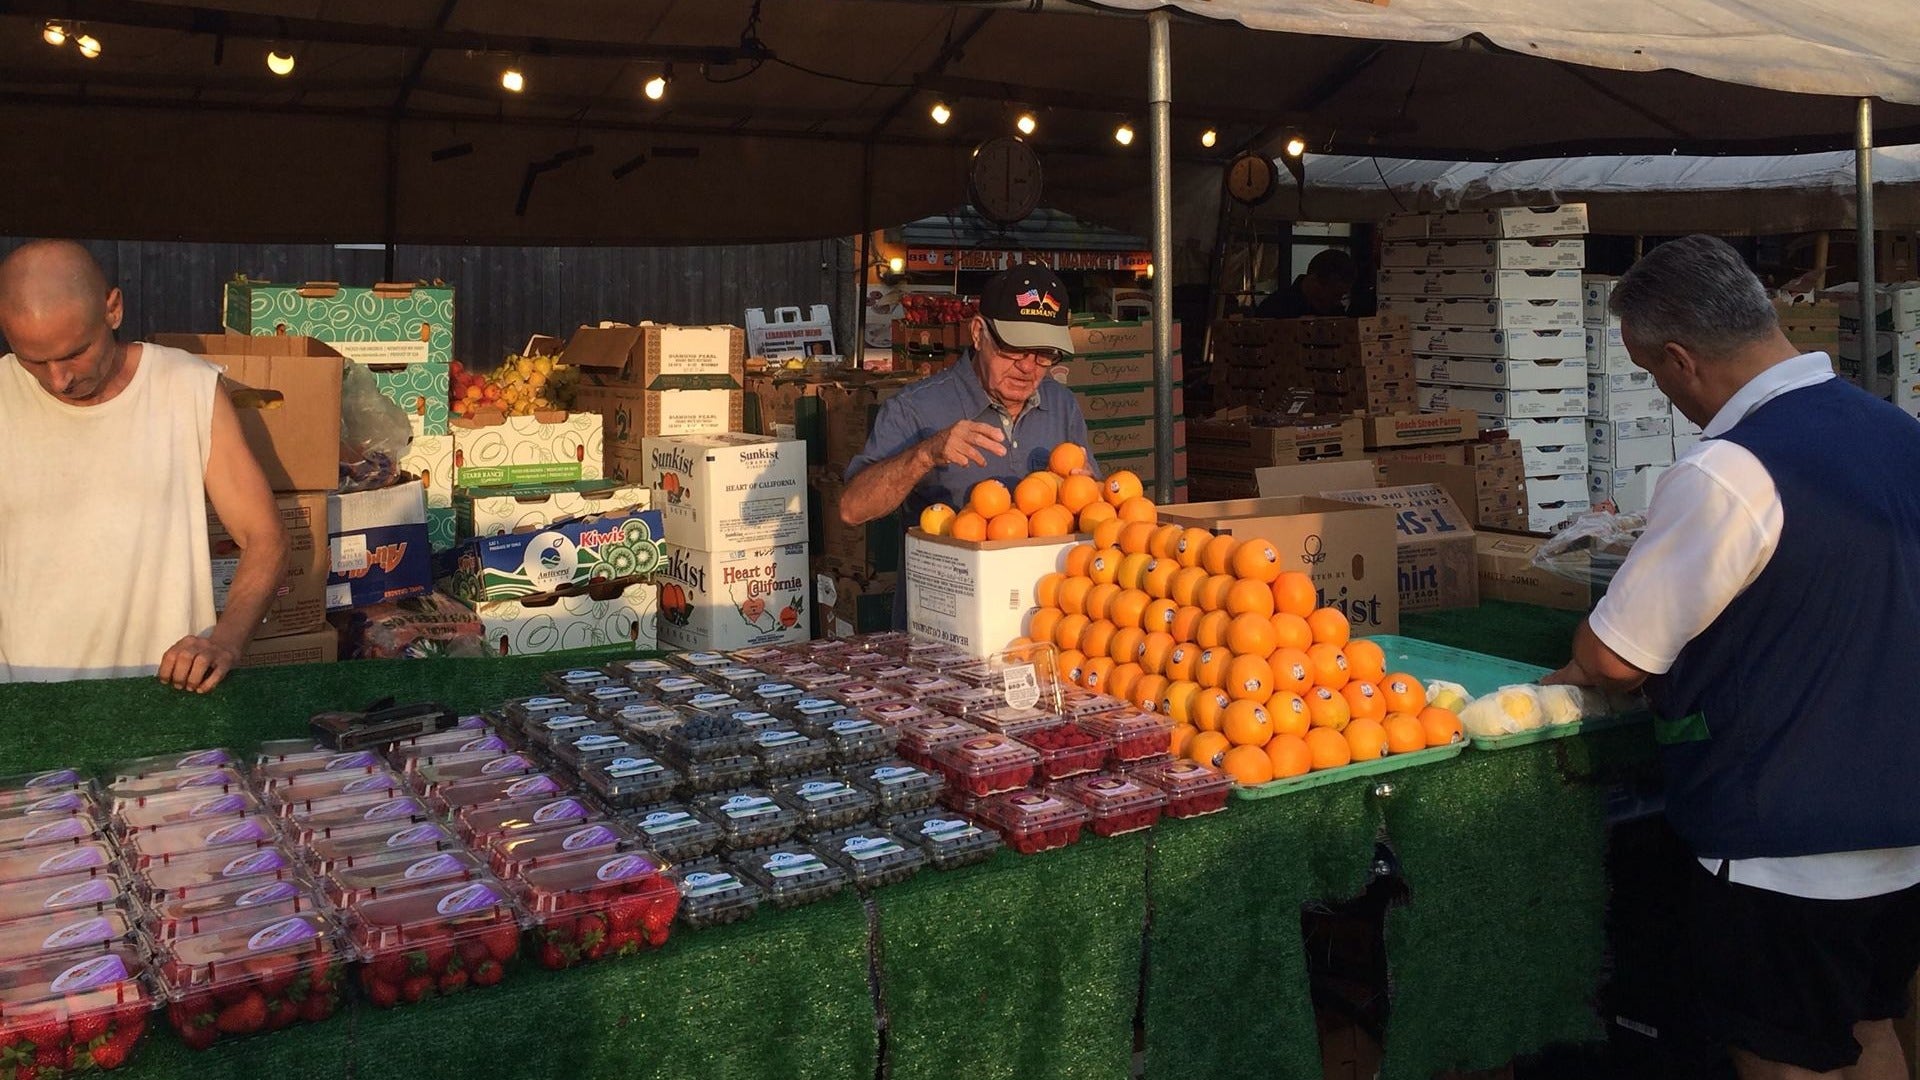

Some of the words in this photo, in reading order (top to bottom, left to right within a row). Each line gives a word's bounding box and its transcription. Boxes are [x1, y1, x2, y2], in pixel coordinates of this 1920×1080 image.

[960, 251, 1002, 267] MEAT
[1058, 251, 1117, 268] MARKET
[1020, 308, 1057, 318] GERMANY
[1088, 331, 1136, 347] Organic
[1091, 362, 1139, 382] Organic
[1090, 397, 1139, 417] Organic
[1440, 418, 1461, 426] Farms
[1092, 431, 1141, 449] Organic
[651, 447, 694, 478] Sunkist
[740, 448, 779, 462] Sunkist
[463, 472, 485, 480] STARR
[485, 471, 504, 479] RANCH
[759, 479, 796, 489] CALIFORNIA
[1381, 492, 1404, 500] TIPO
[579, 526, 625, 548] Kiwis
[723, 565, 761, 584] Heart
[765, 563, 777, 578] of
[1511, 575, 1539, 586] 20MIC
[748, 577, 802, 597] California
